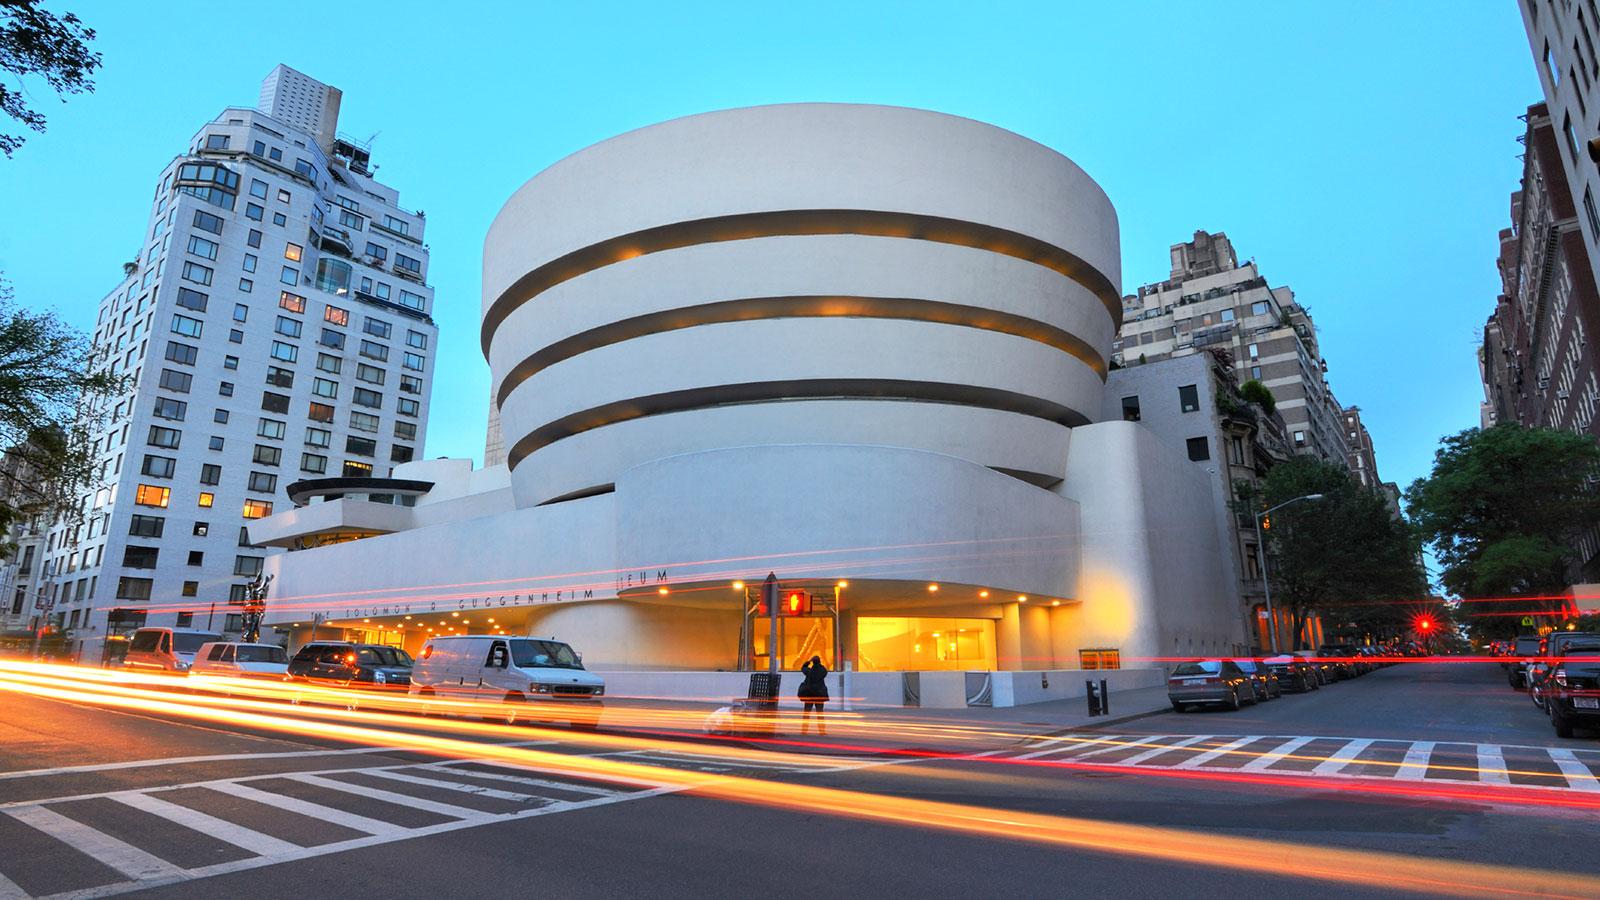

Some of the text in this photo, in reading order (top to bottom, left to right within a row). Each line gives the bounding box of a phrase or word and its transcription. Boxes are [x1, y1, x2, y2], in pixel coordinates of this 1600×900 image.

[345, 604, 410, 617] SOLOMON
[458, 590, 593, 609] GUGGENHEIM
[619, 569, 667, 589] EUM
